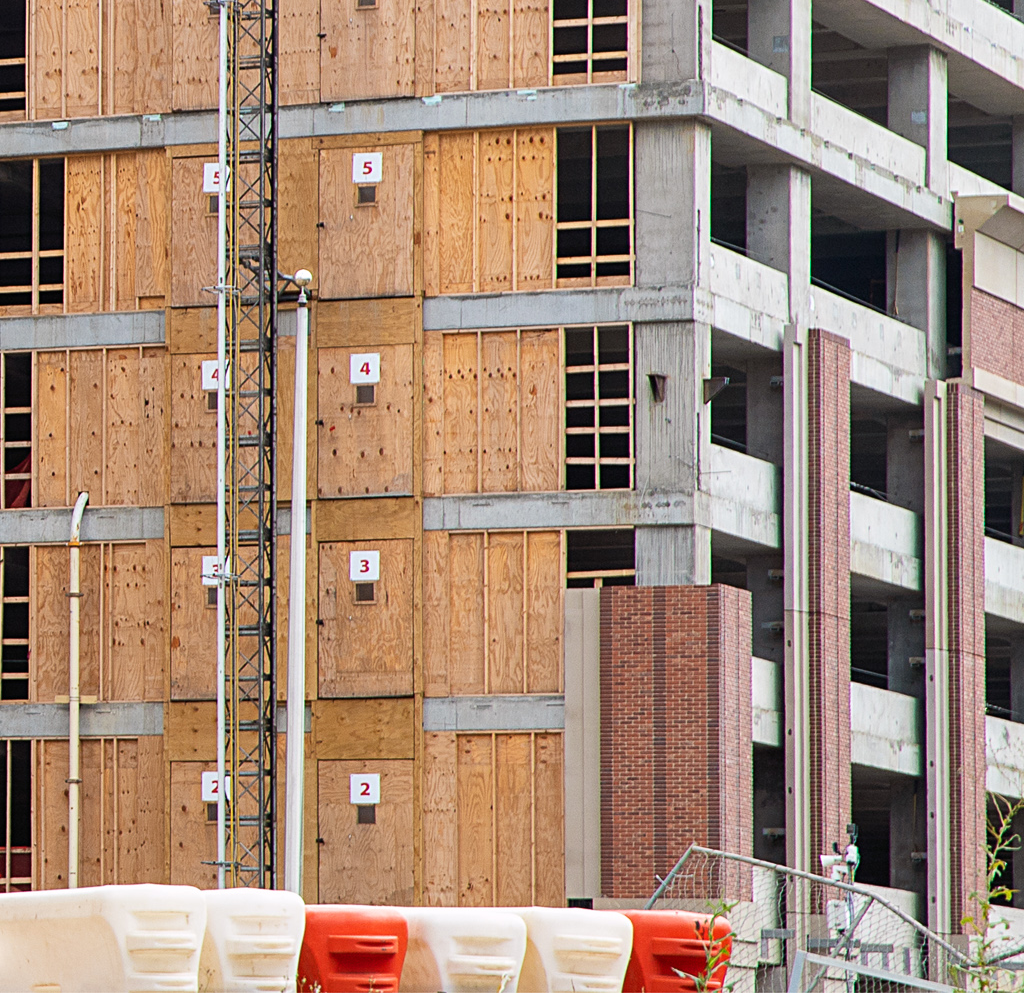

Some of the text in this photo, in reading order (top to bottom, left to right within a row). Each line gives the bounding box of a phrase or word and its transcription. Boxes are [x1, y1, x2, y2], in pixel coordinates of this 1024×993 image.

[362, 161, 373, 175] 5
[360, 362, 370, 375] 4
[359, 559, 370, 573] 3
[211, 780, 218, 794] 2
[360, 782, 370, 796] 2
